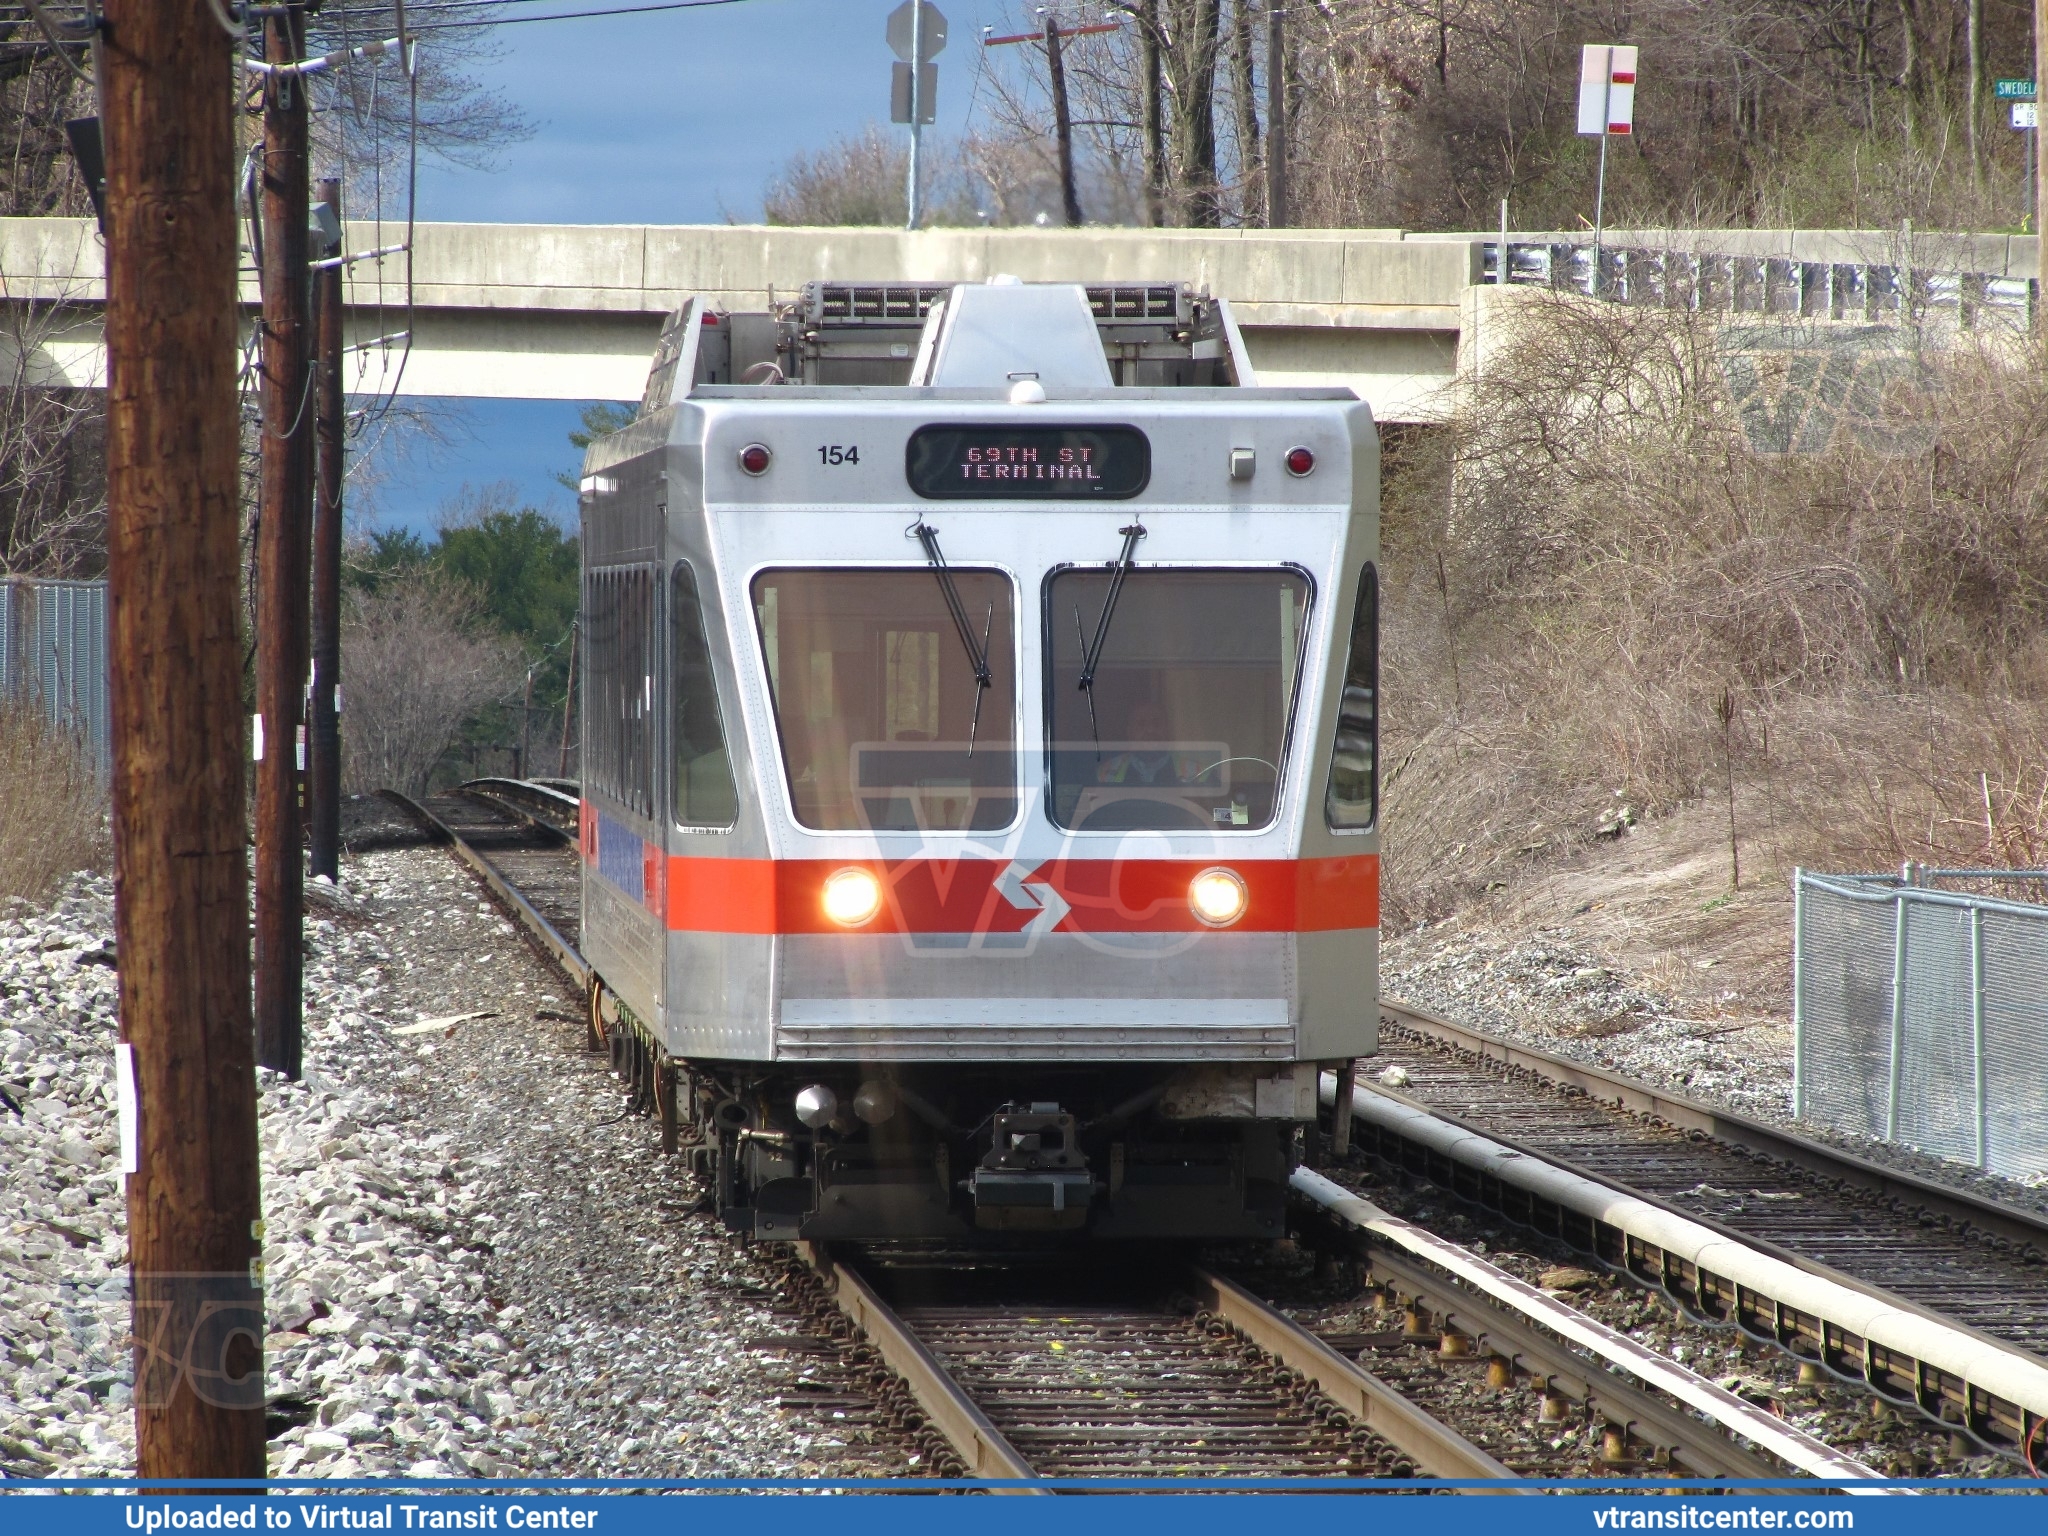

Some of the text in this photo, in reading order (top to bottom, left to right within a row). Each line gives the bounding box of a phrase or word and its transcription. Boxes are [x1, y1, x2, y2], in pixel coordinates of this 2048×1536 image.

[818, 445, 860, 466] 154
[967, 447, 1092, 462] 69TH ST
[960, 464, 1101, 479] TERMINAL
